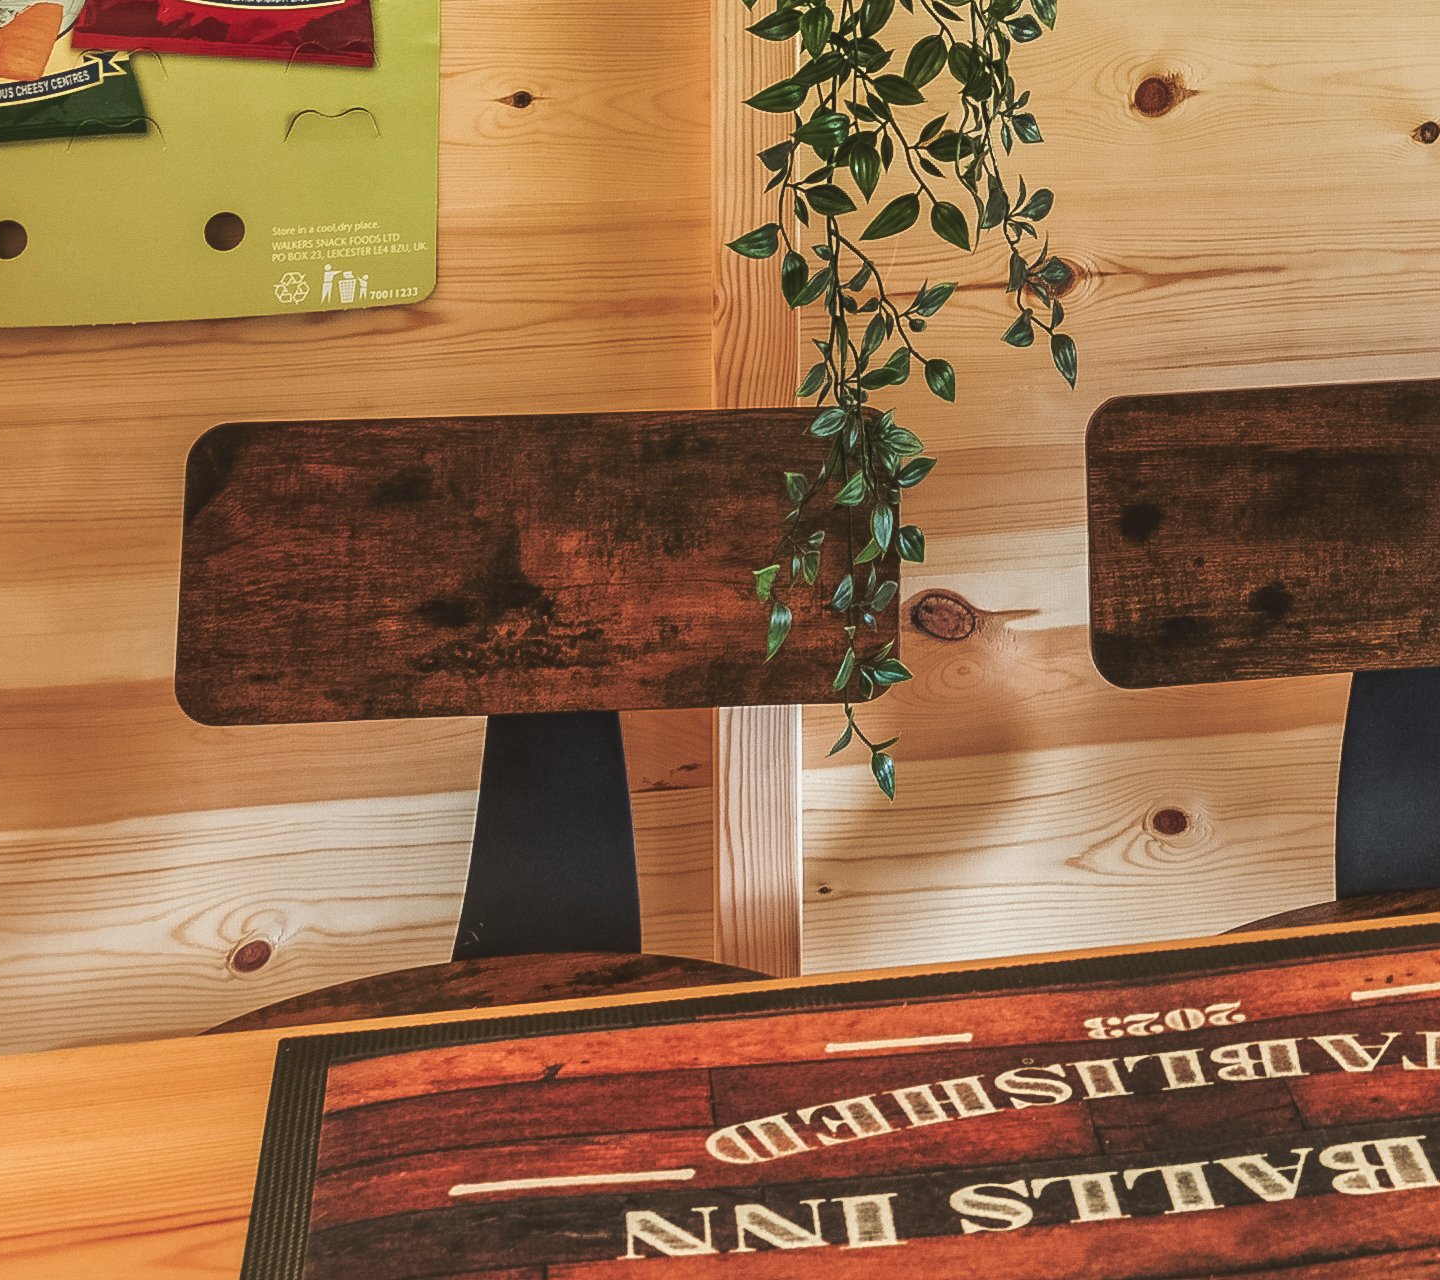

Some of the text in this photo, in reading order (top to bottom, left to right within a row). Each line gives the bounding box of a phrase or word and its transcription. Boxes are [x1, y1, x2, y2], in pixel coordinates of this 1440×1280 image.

[15, 81, 49, 97] CHEESY
[50, 70, 90, 90] CENTRES
[272, 221, 380, 236] Store place.
[272, 233, 400, 251] WALKERS SNACK FOODS LTD
[272, 246, 388, 262] PO BOX LEICESTER LE4
[370, 287, 418, 300] 70011233
[1083, 998, 1246, 1040] 2023
[623, 1191, 907, 1263] INN
